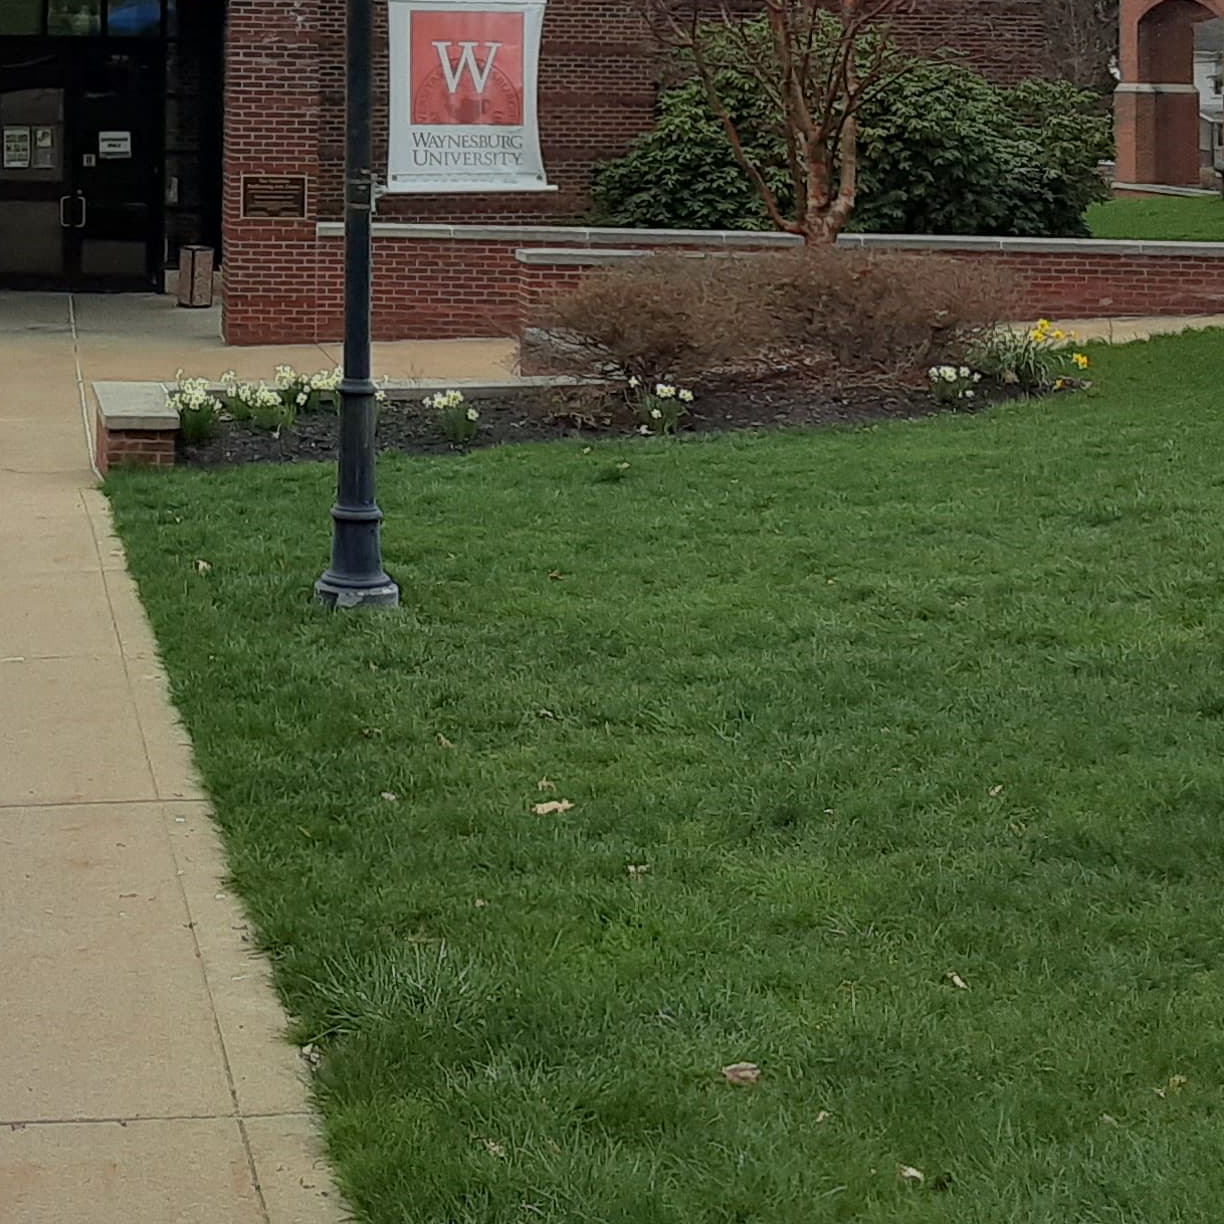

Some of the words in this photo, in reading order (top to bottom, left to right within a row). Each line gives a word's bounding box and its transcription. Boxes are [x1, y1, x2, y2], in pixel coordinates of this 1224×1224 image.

[431, 41, 502, 94] W
[412, 131, 523, 149] WAYNESBURG
[412, 149, 523, 166] UNIVERSITY
